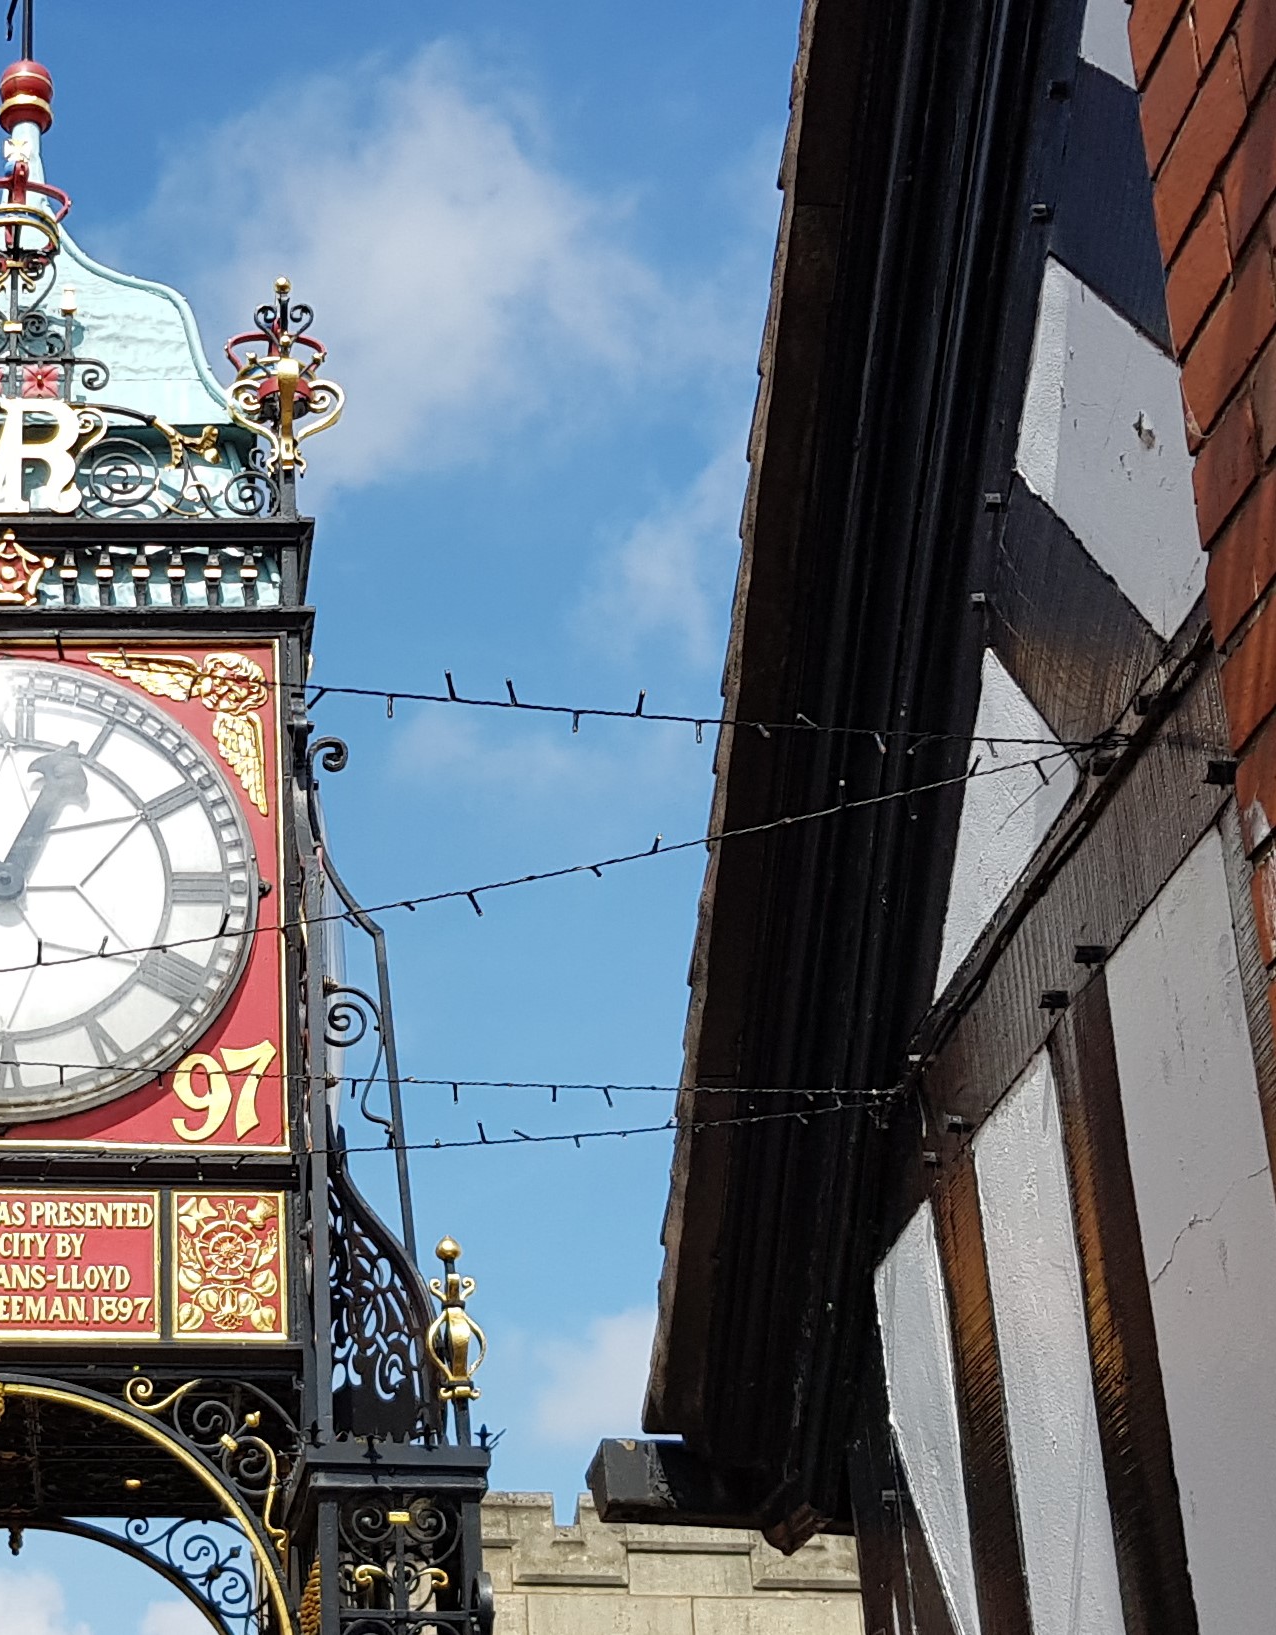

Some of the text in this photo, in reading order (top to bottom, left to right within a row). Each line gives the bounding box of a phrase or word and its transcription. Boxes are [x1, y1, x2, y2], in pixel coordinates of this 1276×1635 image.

[171, 1039, 277, 1143] 97
[30, 1201, 154, 1228] PRESENTED
[56, 1232, 86, 1259] BY
[91, 1296, 154, 1324] 1897.
